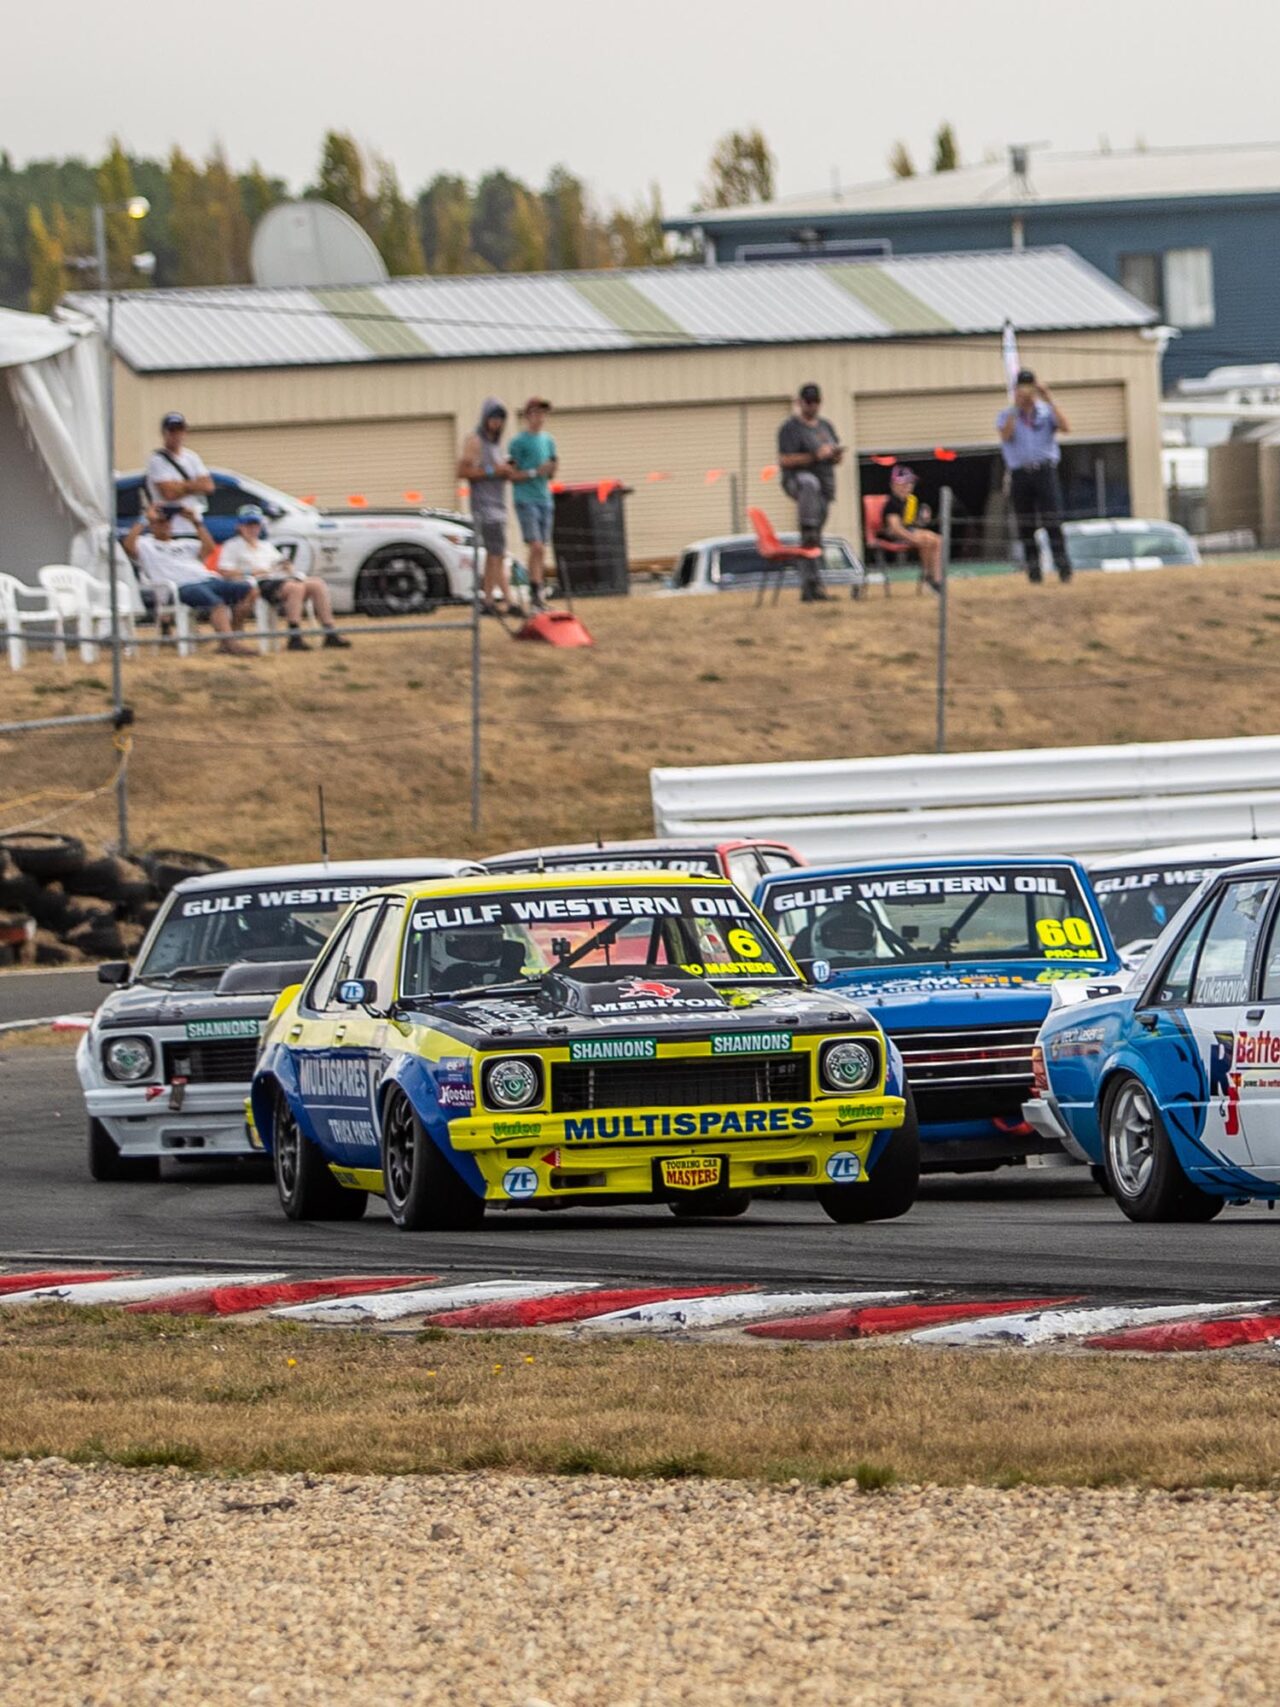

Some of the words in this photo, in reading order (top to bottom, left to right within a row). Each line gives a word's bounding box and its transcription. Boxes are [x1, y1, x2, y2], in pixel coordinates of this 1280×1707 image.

[1093, 873, 1160, 893] GULF
[773, 885, 853, 912] GULF
[862, 876, 1009, 900] WESTERN
[1012, 876, 1066, 895] OIL
[182, 894, 252, 917] GULF
[411, 906, 503, 931] GULF
[510, 897, 682, 921] WESTERN
[690, 898, 751, 918] OIL
[1035, 917, 1093, 947] 60
[728, 929, 762, 958] 6
[1043, 949, 1100, 959] PRO-AM
[704, 962, 777, 974] MASTERS
[343, 983, 364, 1000] ZF
[591, 998, 728, 1013] MERITOR
[188, 1020, 259, 1037] SHANNONS
[571, 1040, 655, 1060] SHANNONS
[713, 1034, 790, 1053] SHANNONS
[300, 1058, 368, 1098] MULTISPARES
[838, 1104, 884, 1119] Valeo
[328, 1119, 356, 1144] TRUCK
[351, 1120, 377, 1146] PARTS
[493, 1121, 541, 1136] Valeo
[564, 1106, 815, 1141] MULTISPARES
[666, 1160, 700, 1169] TOURING
[703, 1159, 717, 1167] CAR
[829, 1157, 859, 1178] ZF
[506, 1172, 536, 1192] ZF
[666, 1168, 718, 1186] MASTERS
